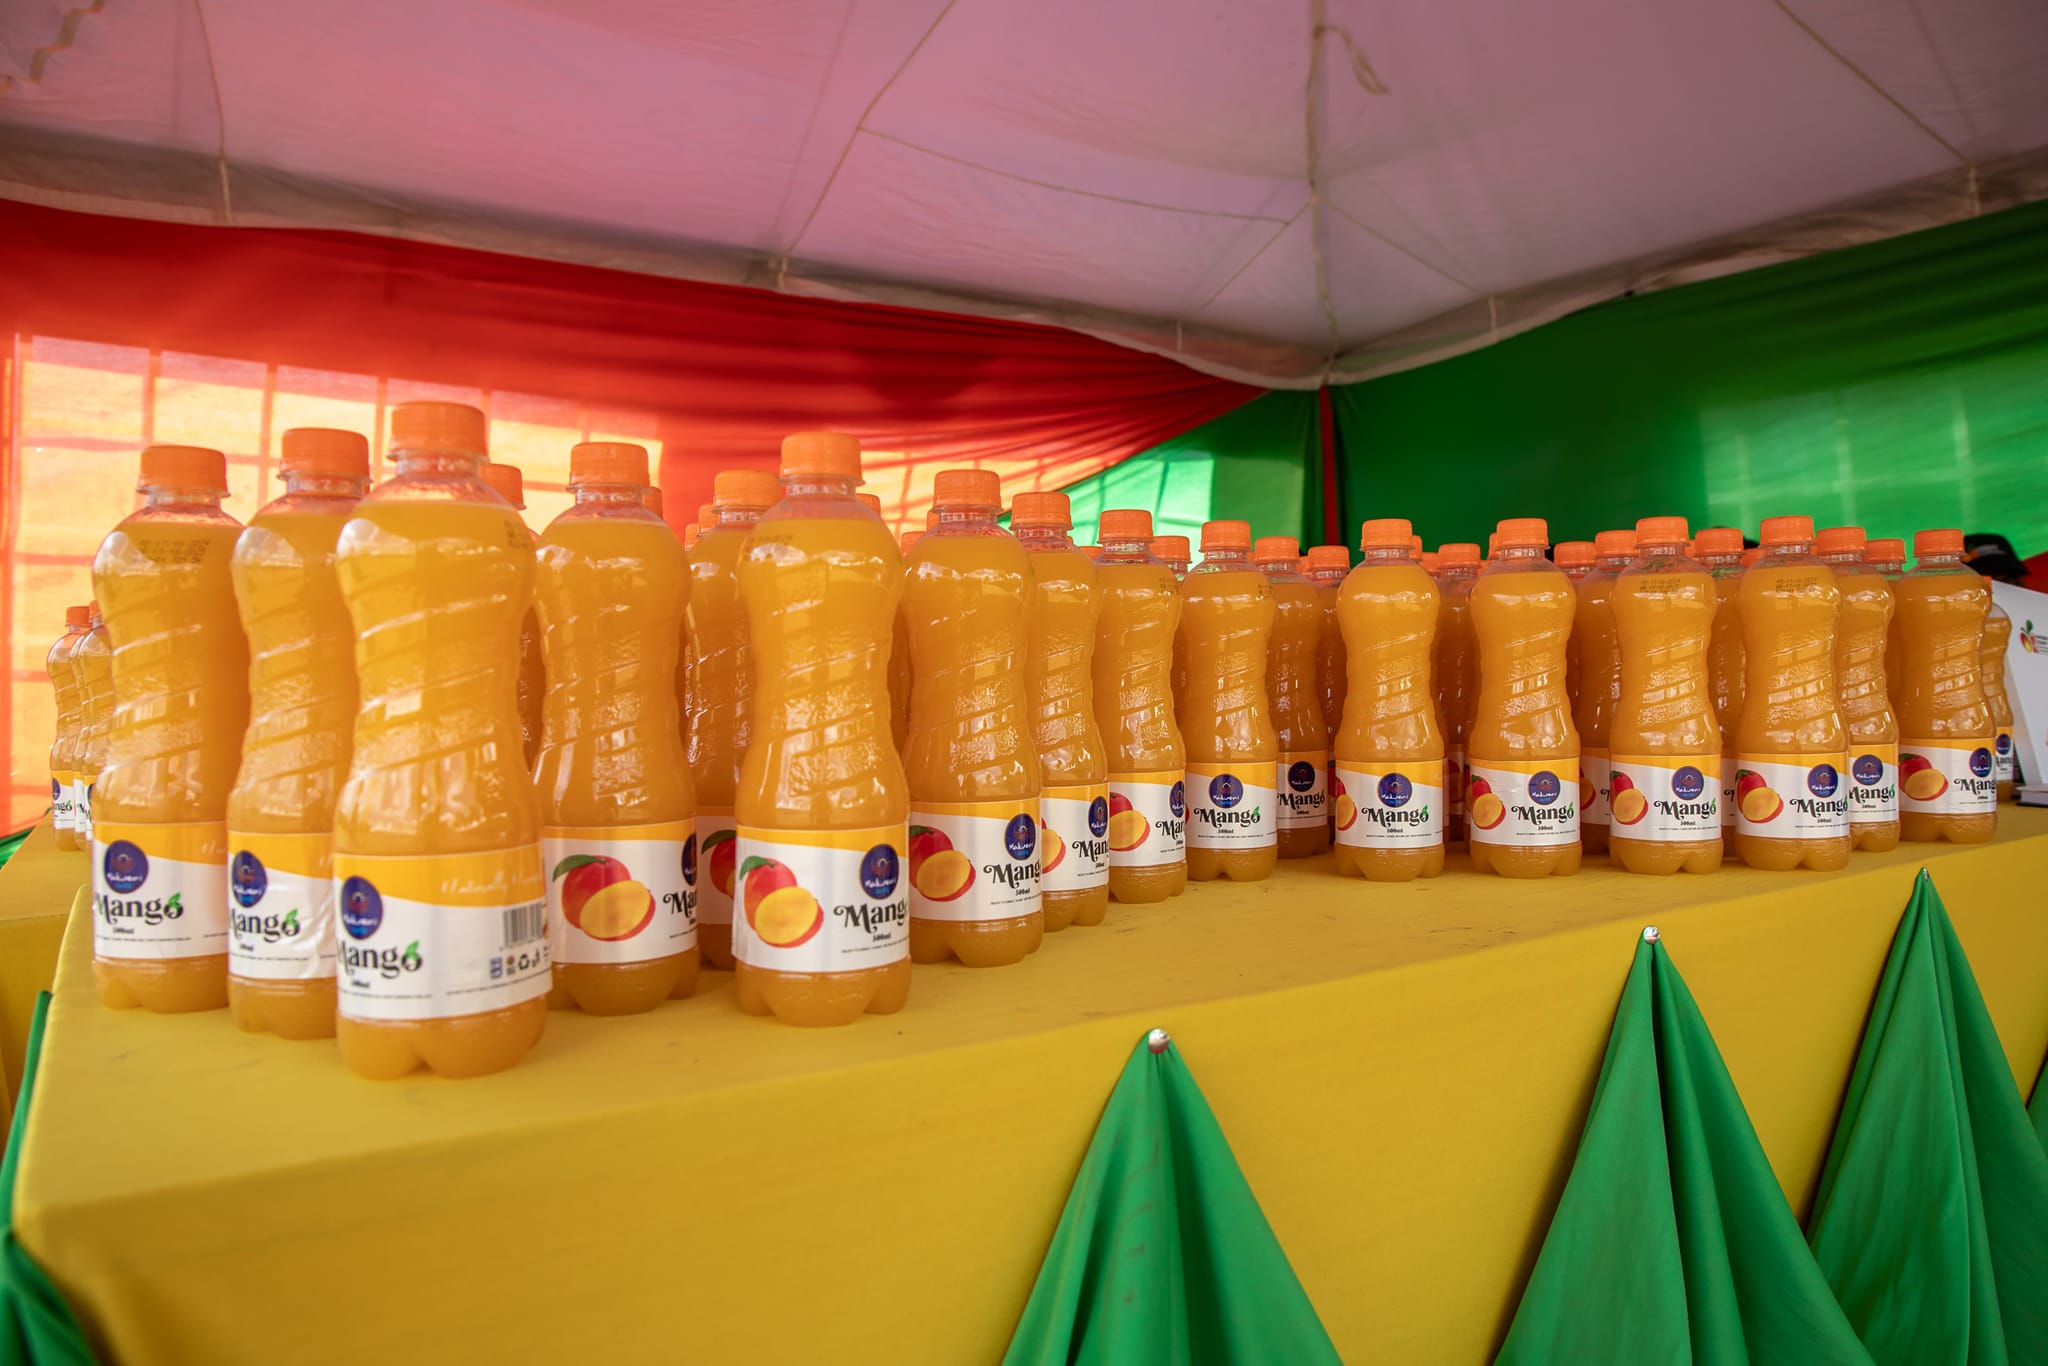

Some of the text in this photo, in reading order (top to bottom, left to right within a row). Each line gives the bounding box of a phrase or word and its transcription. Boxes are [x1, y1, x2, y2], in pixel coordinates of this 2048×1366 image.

[1953, 777, 1997, 796] Mang
[1276, 789, 1325, 811] Mango
[1653, 798, 1717, 821] Mango
[1789, 794, 1849, 818] Mango
[1193, 806, 1261, 828] Mango
[1361, 804, 1429, 828] Mango
[1511, 801, 1575, 826] Mango
[983, 859, 1041, 889] Mang
[833, 897, 909, 933] Mang
